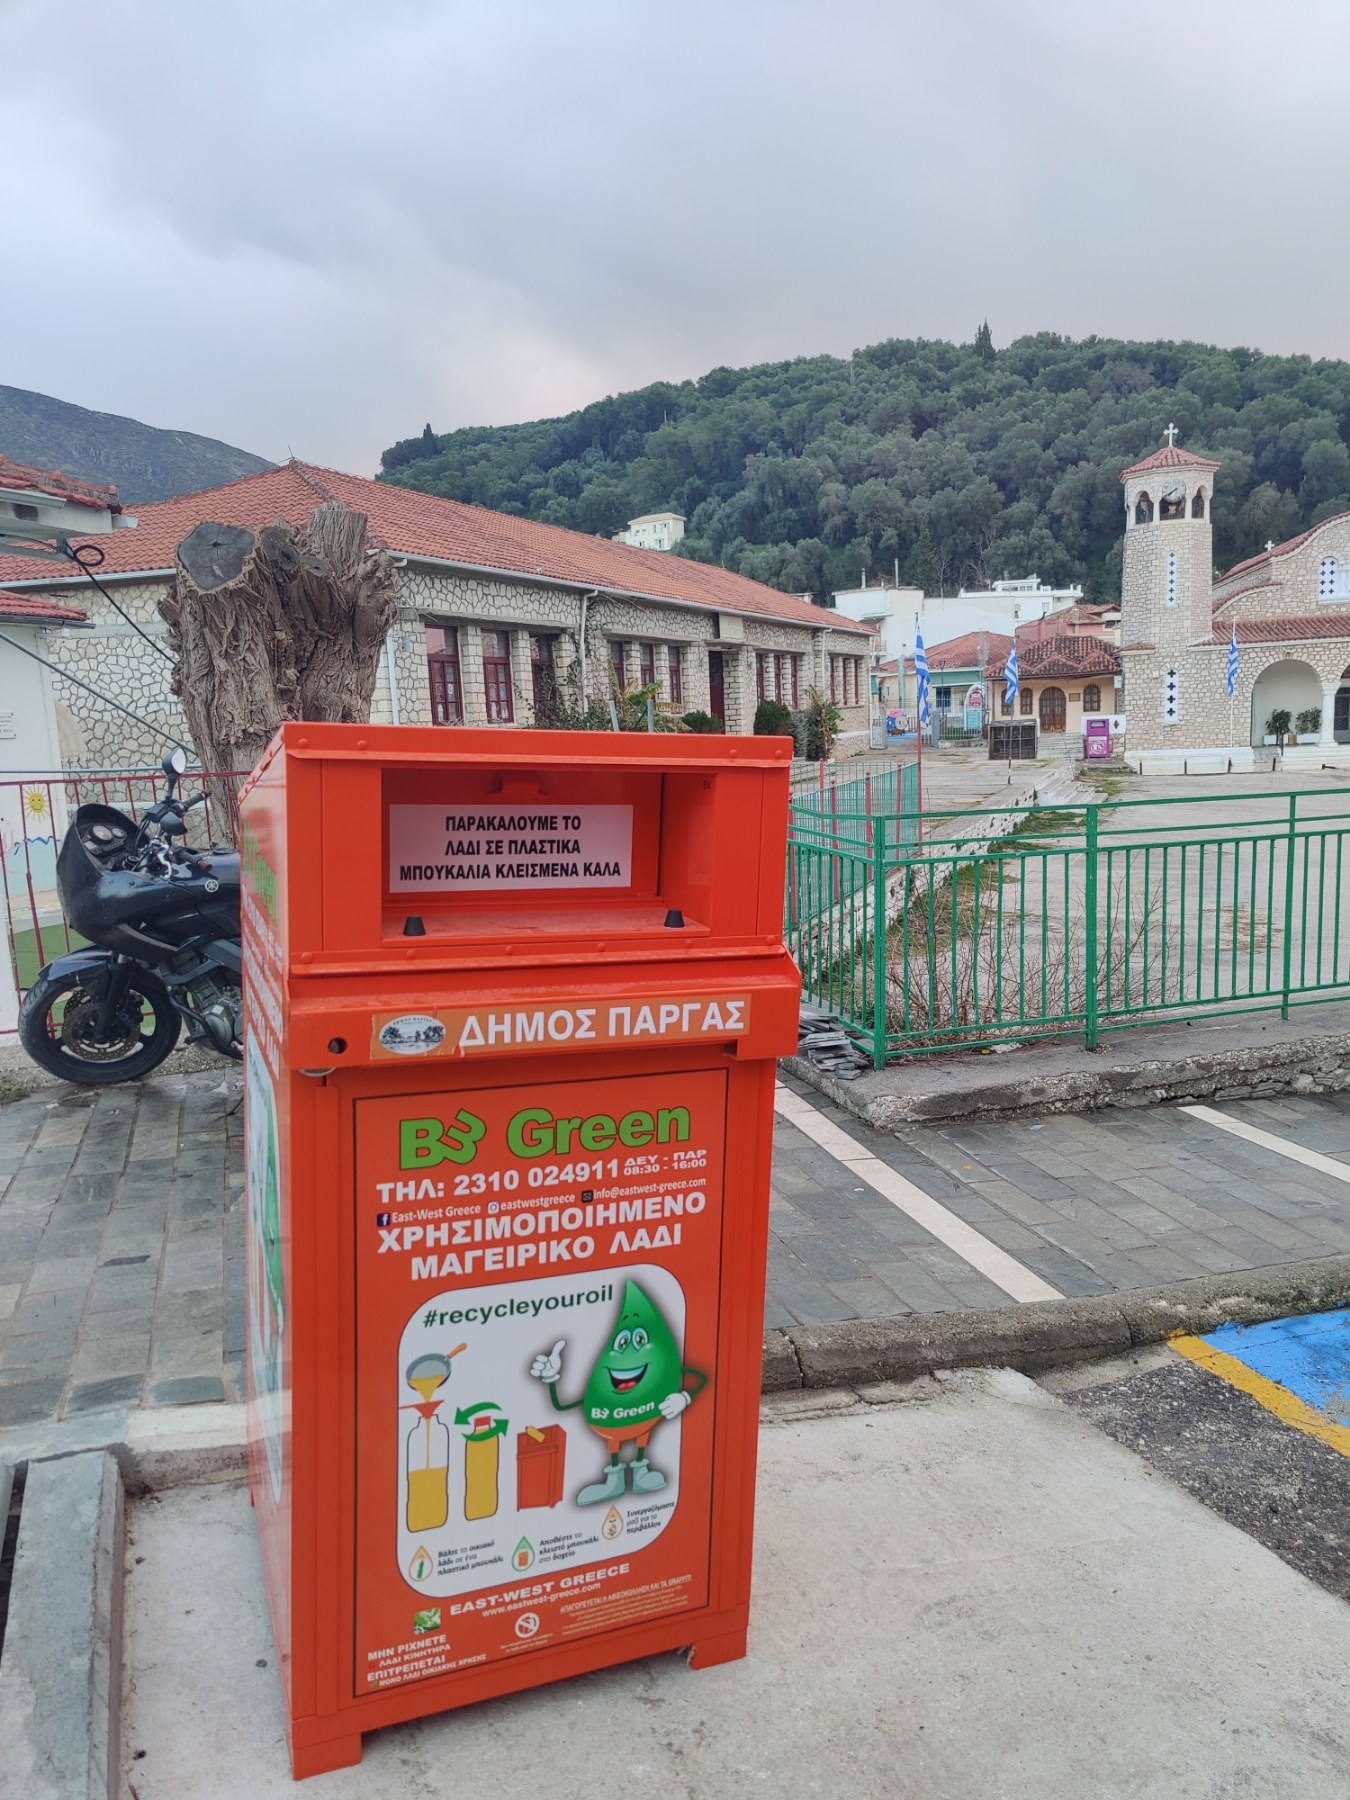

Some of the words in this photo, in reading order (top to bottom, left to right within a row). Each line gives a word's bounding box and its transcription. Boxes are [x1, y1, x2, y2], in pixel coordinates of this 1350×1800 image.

[445, 815, 558, 832] ΠΑΡΑΚΑΛΟΥΜΕ
[563, 815, 581, 831] ΤΟ
[445, 841, 480, 856] ΛΑΔΙ
[486, 840, 503, 855] ΣΕ
[508, 839, 580, 855] ΠΛΑΣΤΙΚΑ
[400, 865, 491, 881] ΜΠΟΥΚΑΛΙΑ
[496, 863, 579, 879] ΚΛΕΙΣΜΕΝΑ
[583, 862, 621, 878] ΚΑΛΑ
[459, 1008, 596, 1047] ΔΗΜΟΣ
[608, 1001, 745, 1037] ΠΑΡΓΑΣ
[506, 1106, 691, 1158] Green
[624, 1155, 658, 1166] ΔΕΥ
[673, 1150, 707, 1161] ΠΑΡ
[624, 1164, 660, 1176] 08:30
[672, 1159, 706, 1170] 16:00
[376, 1179, 444, 1203] ΤΗΛ:
[454, 1170, 519, 1196] 2310
[528, 1158, 618, 1189] 024911
[392, 1209, 443, 1223] East-West
[445, 1204, 481, 1217] Greece
[501, 1193, 575, 1211] eastwestgreece
[594, 1178, 706, 1199] info@eastwest-greece.com
[377, 1191, 706, 1254] ΧΡΗΣΙΜΟΠΟΙΗΜΕΝΟ
[411, 1236, 595, 1280] ΜΑΓΕΙΡΙΚΟ
[609, 1224, 682, 1254] ΛΑΔΙ
[423, 1284, 613, 1328] #recycleyouroil
[613, 1401, 655, 1419] Green
[450, 1581, 555, 1615] EAST-WEST
[560, 1563, 630, 1588] GREECE
[482, 1582, 601, 1617] www.eastwest-greece.com
[367, 1647, 395, 1661] ΜΗΝ
[398, 1634, 447, 1653] ΡΙΧΝΕΤΕ
[379, 1657, 402, 1667] ΛΑΔΙ
[404, 1644, 451, 1661] ΚΙΝΗΤΗΡΑ
[367, 1655, 446, 1681] ΕΠΙΤΡΕΠΕΤΑΙ
